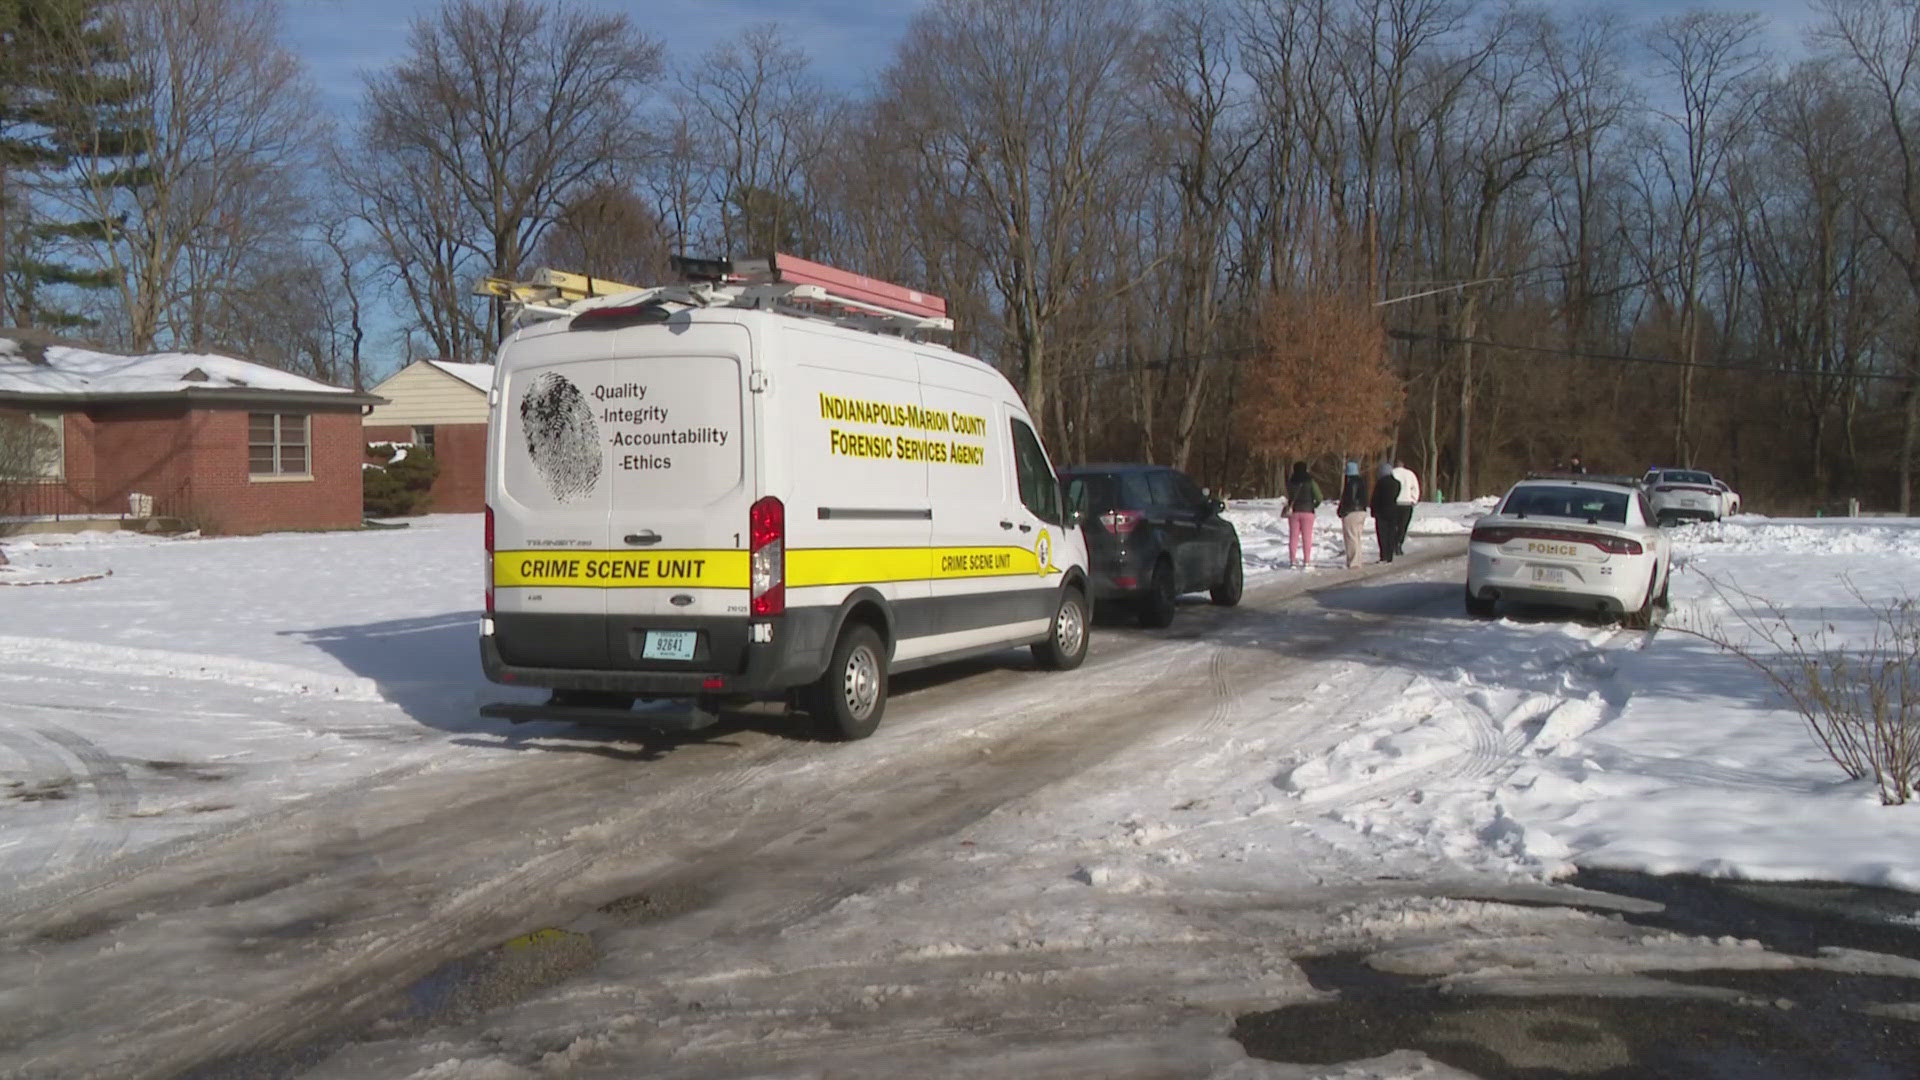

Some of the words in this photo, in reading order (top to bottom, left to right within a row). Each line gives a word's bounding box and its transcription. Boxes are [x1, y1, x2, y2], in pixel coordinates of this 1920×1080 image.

[591, 383, 648, 401] -Quality
[600, 406, 668, 425] -Integrity
[819, 392, 950, 432] INDIANAPOLIS-MARION
[952, 411, 986, 437] COUNTY
[609, 428, 729, 446] -Accountability
[830, 429, 893, 459] FORENSIC
[896, 436, 947, 463] SERVICES
[950, 442, 984, 466] AGENCY
[619, 454, 672, 470] -Ethics
[733, 533, 741, 548] 1
[1528, 542, 1577, 556] POLICE
[521, 560, 580, 578] CRIME
[585, 560, 650, 579] SCENE
[656, 559, 706, 578] UNIT
[941, 554, 968, 572] CRIME
[969, 554, 994, 570] SCENE
[995, 553, 1011, 569] UNIT
[656, 638, 683, 652] 92641
